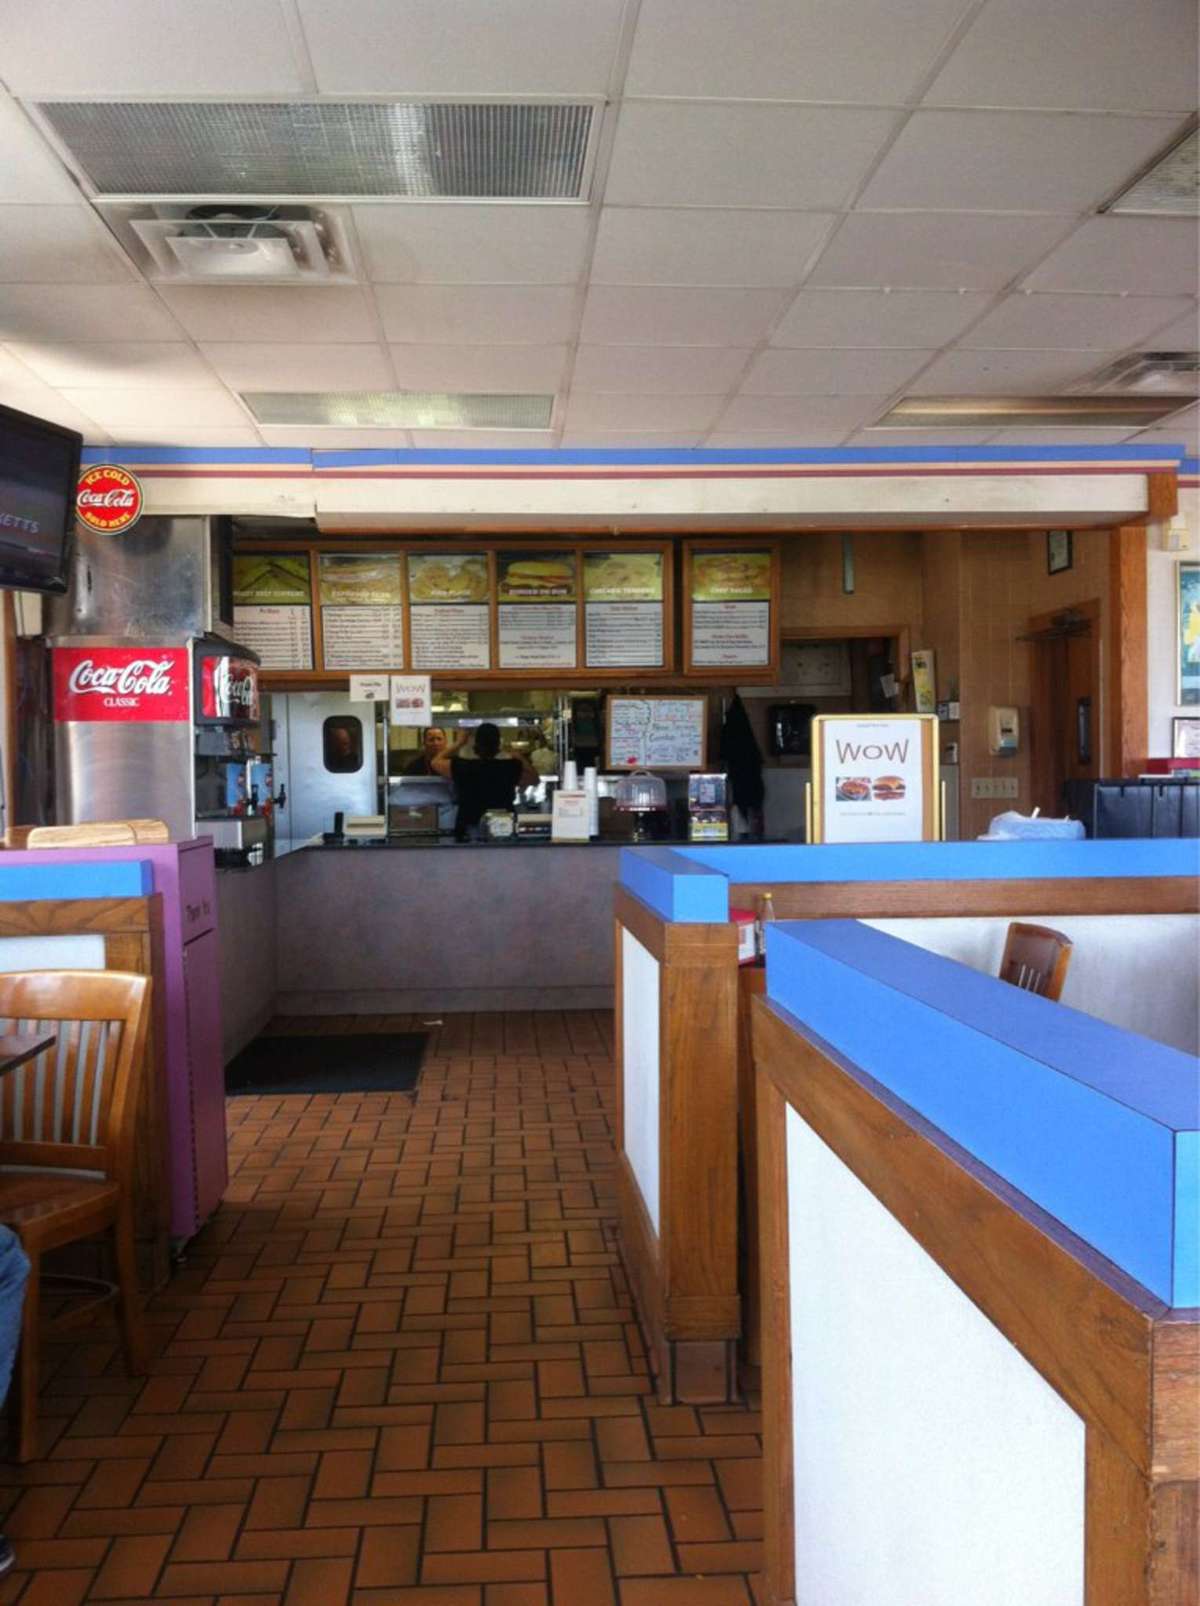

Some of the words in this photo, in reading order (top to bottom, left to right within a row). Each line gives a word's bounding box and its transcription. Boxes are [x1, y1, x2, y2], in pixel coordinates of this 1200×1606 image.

[86, 471, 103, 485] ICE
[103, 470, 130, 486] COLD
[86, 511, 107, 527] SOLD
[104, 697, 140, 708] CLASSIC
